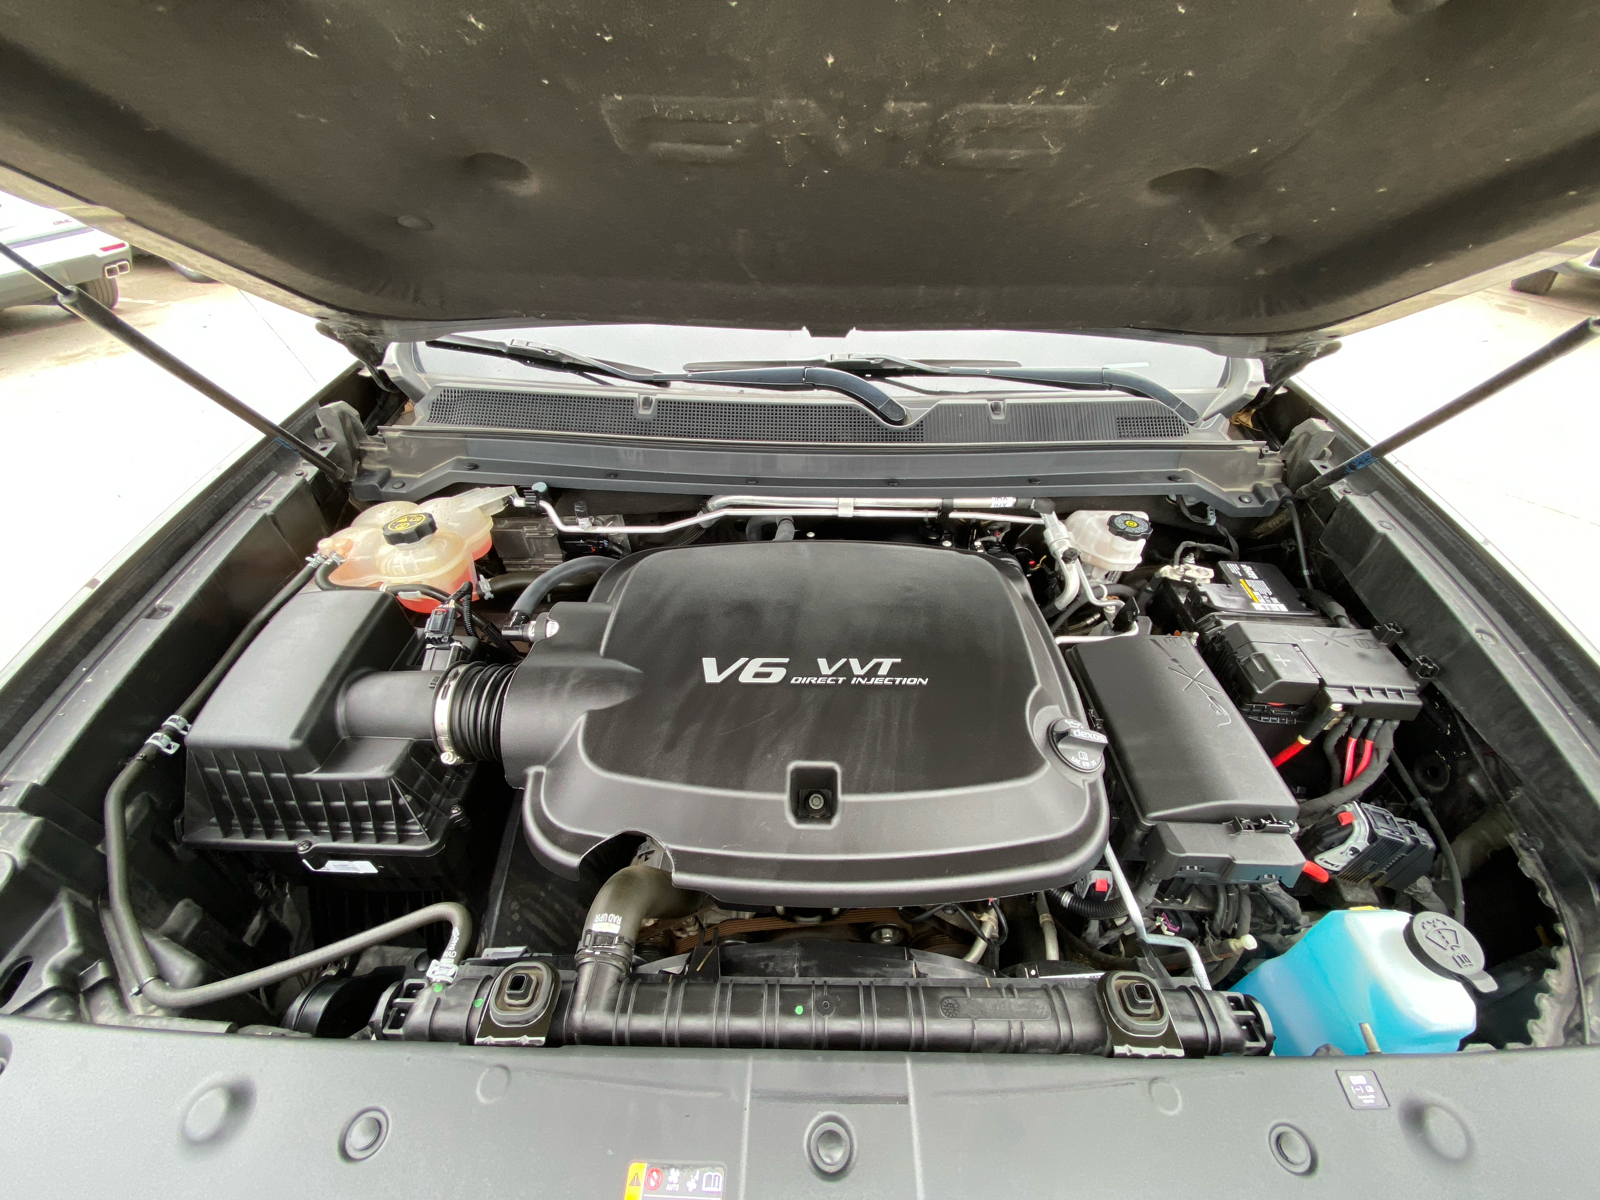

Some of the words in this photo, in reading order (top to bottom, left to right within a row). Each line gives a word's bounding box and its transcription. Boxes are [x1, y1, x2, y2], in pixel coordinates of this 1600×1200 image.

[702, 657, 790, 684] V6
[816, 657, 902, 676] VVT
[790, 676, 846, 685] DIRECT
[851, 677, 929, 686] INJECTION
[1073, 729, 1106, 743] dexos
[608, 913, 623, 925] RAD
[666, 1183, 680, 1192] AUTO
